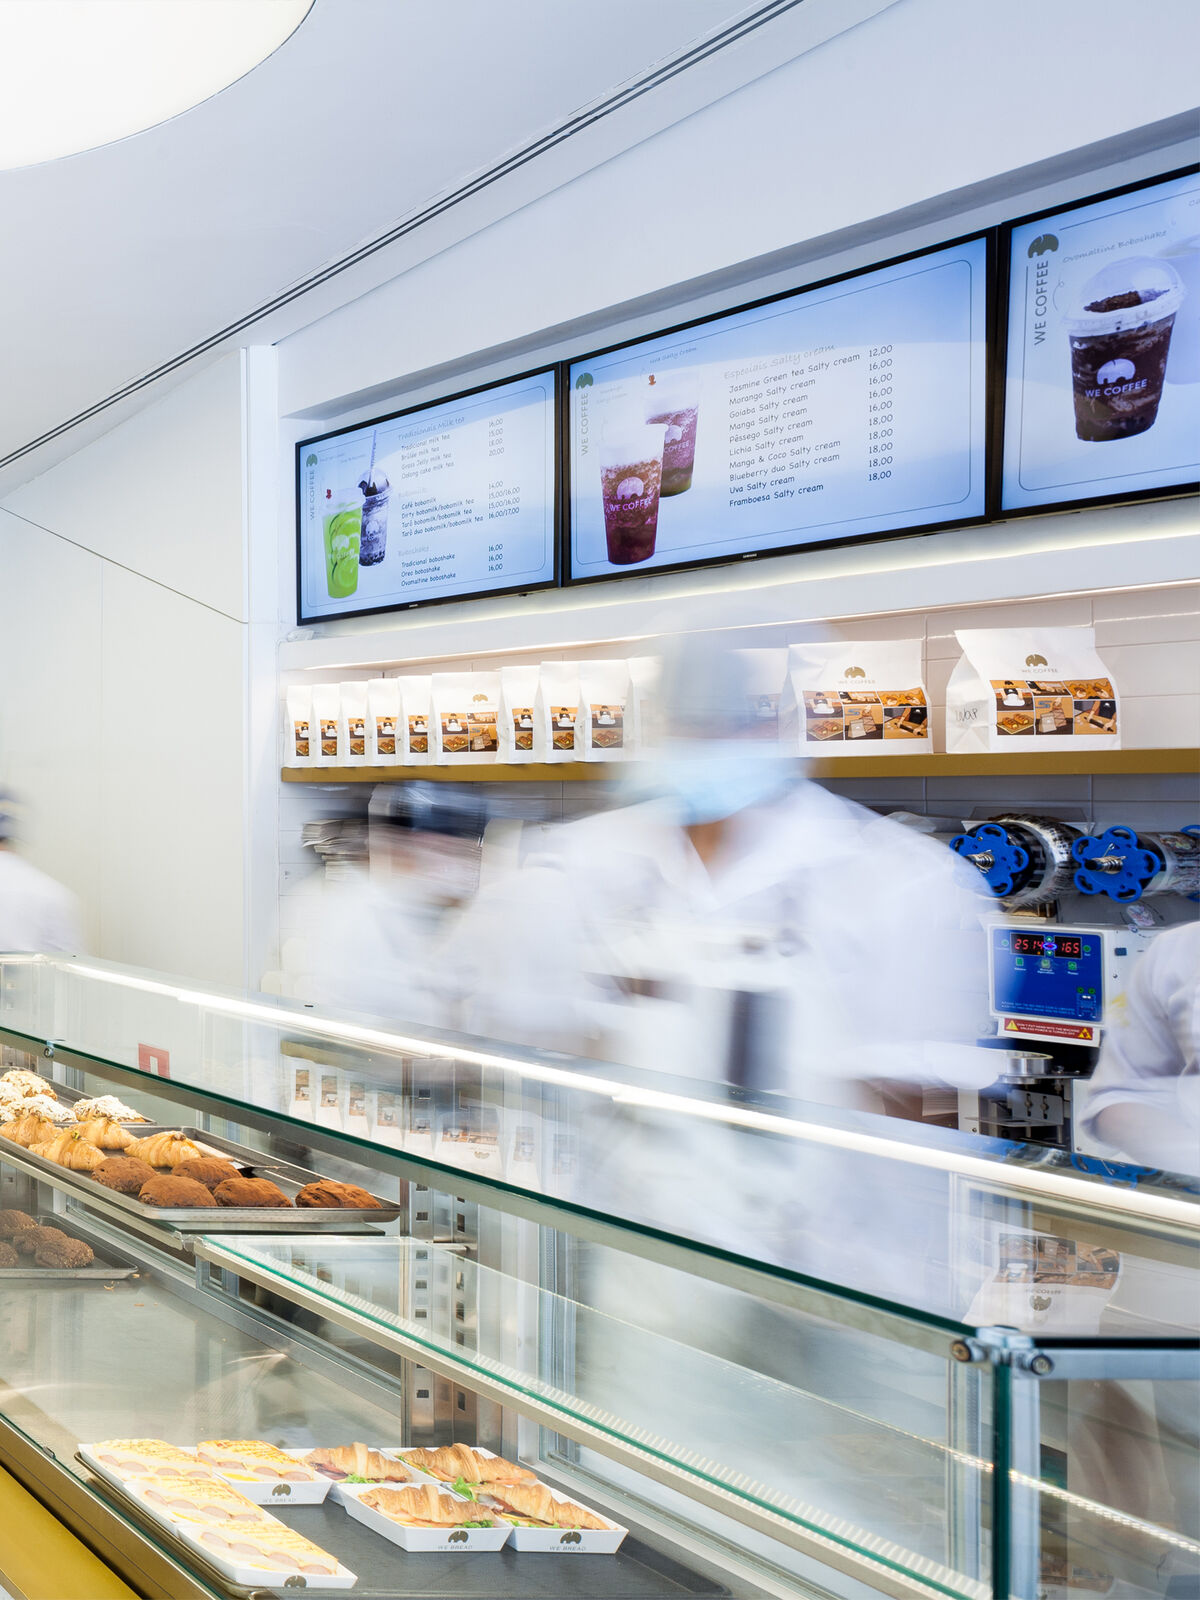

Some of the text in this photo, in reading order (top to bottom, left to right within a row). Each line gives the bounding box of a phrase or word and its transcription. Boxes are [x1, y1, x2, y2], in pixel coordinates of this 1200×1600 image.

[1034, 260, 1049, 346] WE COFFEE
[728, 345, 893, 394] Jasmine Green tea Salty cream 12,00
[728, 358, 893, 406] Morango Salty cream 16,00
[1085, 378, 1148, 398] WE COFFEE
[729, 372, 893, 419] Goiaba Salty cream 16,00
[729, 386, 893, 432] Manga Salty cream 16,00
[581, 392, 589, 456] WE COFFEE
[729, 400, 893, 444] Pêssego Salty cream 16,00
[729, 414, 893, 456] Lichia Salty cream 18,00
[729, 428, 893, 469] Manga & Coco Salty cream 18,00
[729, 442, 893, 482] Blueberry duo Salty cream 18,00
[729, 456, 893, 494] Uva Salty cream 18,00
[729, 470, 892, 507] Framboesa Salty cream 18,00
[609, 496, 652, 512] WE COFFEE
[401, 557, 428, 568] Tradicional
[401, 569, 413, 577] Oreo
[1061, 942, 1079, 954] 165
